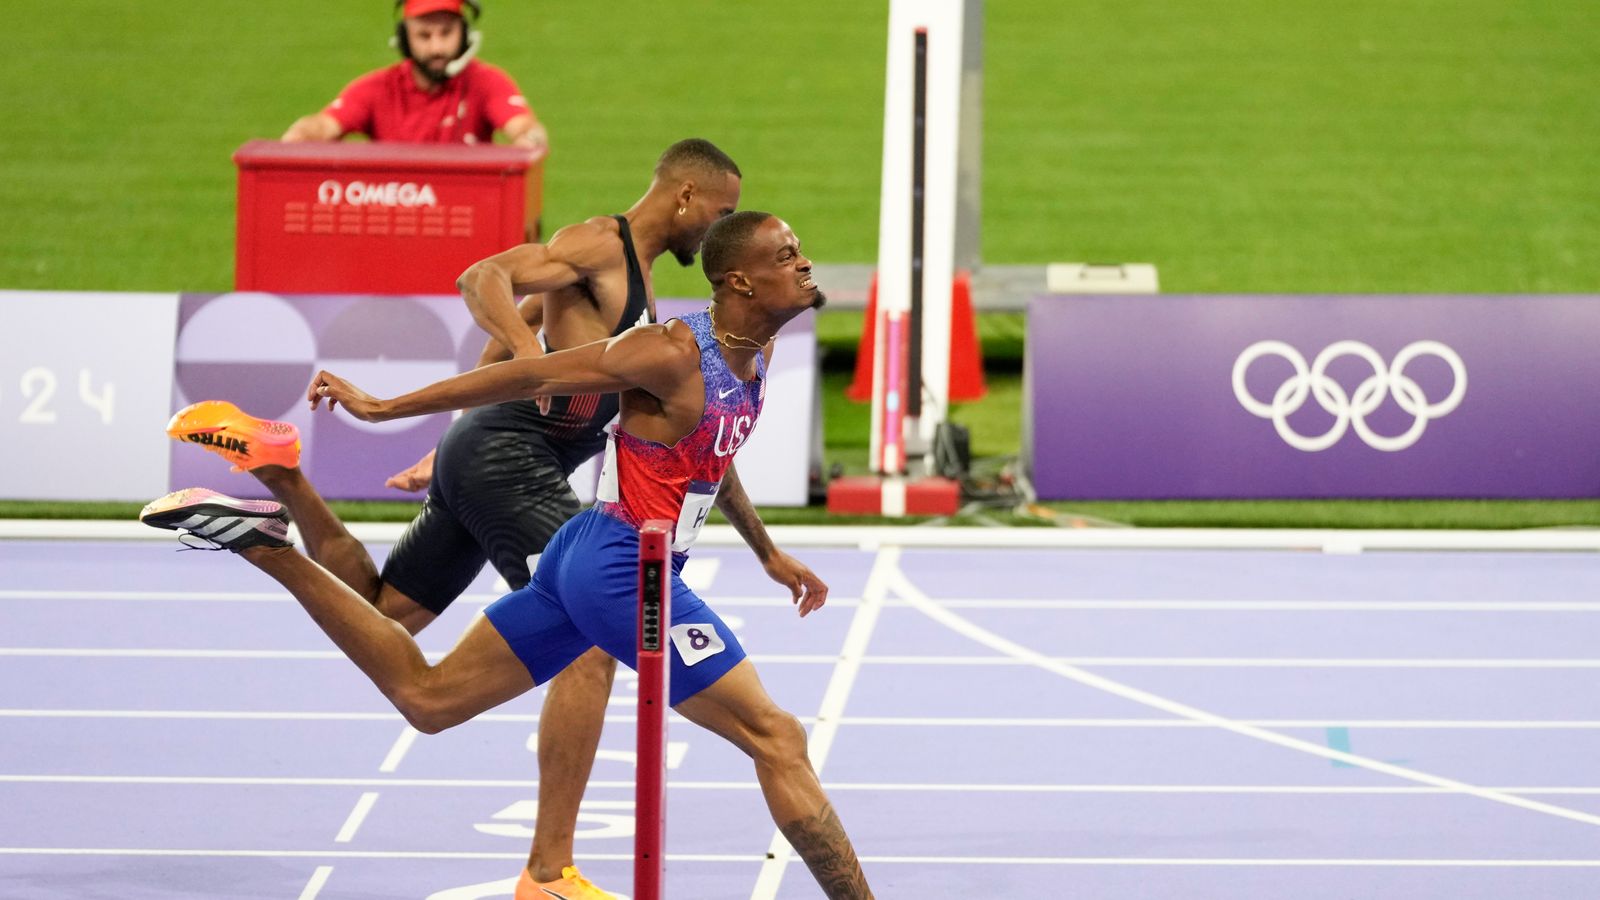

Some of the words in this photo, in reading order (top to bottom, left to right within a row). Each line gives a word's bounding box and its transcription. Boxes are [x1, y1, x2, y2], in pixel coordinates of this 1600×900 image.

[345, 181, 437, 207] OMEGA
[0, 366, 115, 425] 24
[187, 432, 251, 456] NITRO
[687, 627, 709, 650] 8
